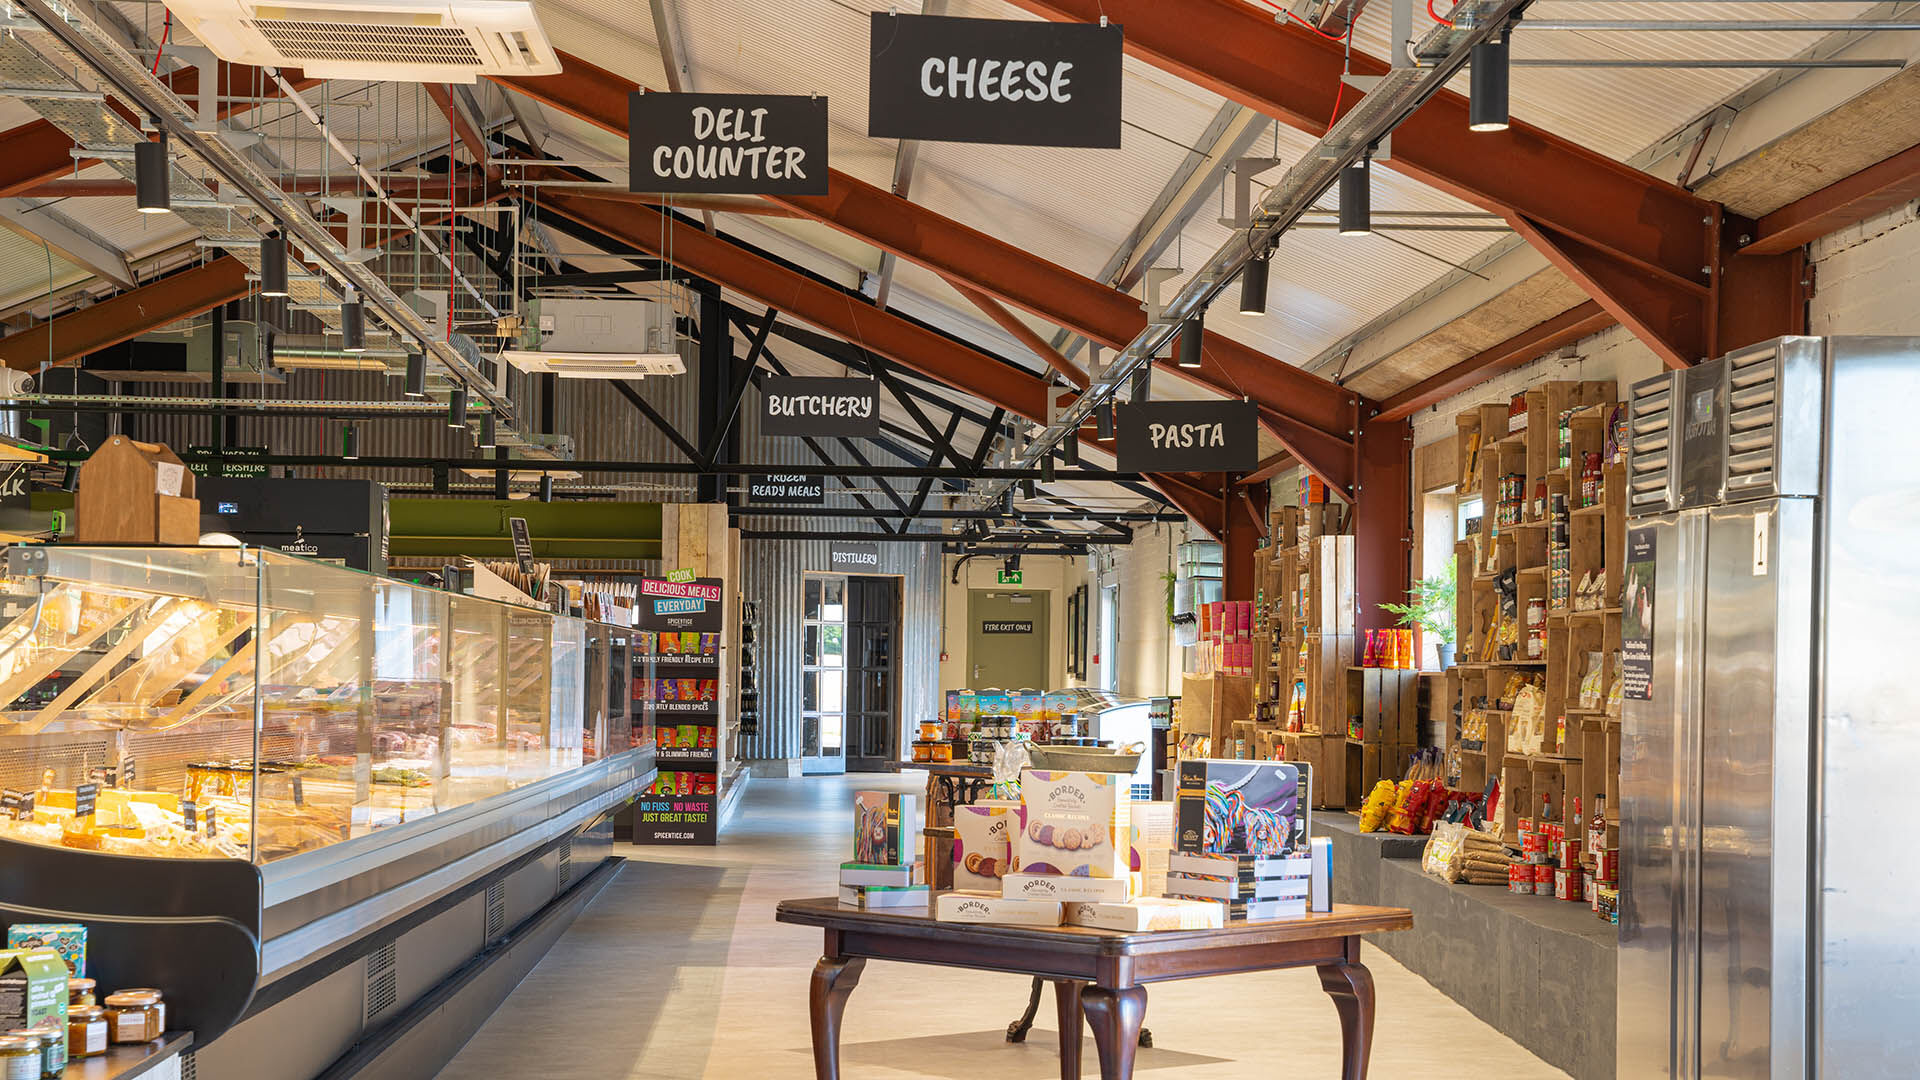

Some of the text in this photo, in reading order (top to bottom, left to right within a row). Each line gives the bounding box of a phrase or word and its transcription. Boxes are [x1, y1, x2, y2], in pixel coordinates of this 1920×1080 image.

[920, 57, 1074, 103] CHEESE
[691, 107, 768, 142] DELI
[652, 145, 806, 180] COUNTER
[768, 395, 873, 418] BUTCHERY
[1149, 423, 1225, 448] PASTA
[752, 485, 821, 497] READY MEALS
[281, 544, 318, 552] meatico
[832, 551, 877, 565] DISTILLERY
[669, 569, 693, 583] COOK
[643, 581, 717, 598] DELICIOUS MEALS
[657, 599, 702, 612] EVERYDAY
[984, 623, 1031, 631] FIRE EXIT ONLY
[1049, 785, 1085, 802] BORDER
[640, 802, 709, 812] NO FUSS NO WASTE
[642, 813, 708, 823] JUST GREAT TASTE!
[1023, 880, 1056, 893] BORDER
[957, 901, 990, 914] BORDER
